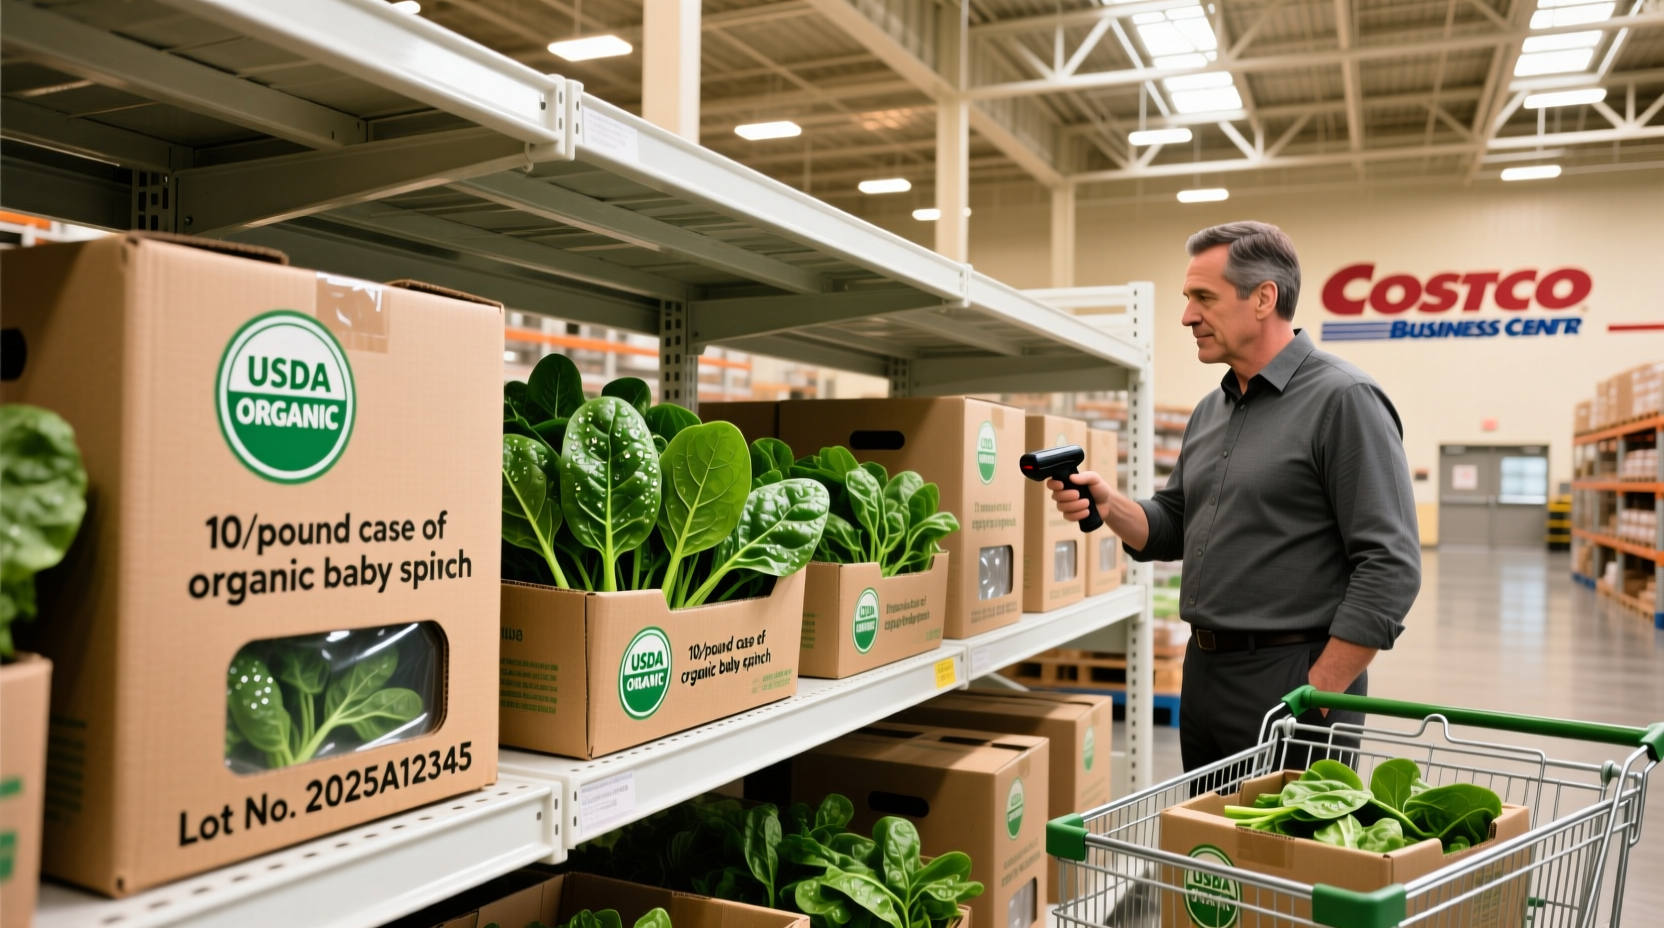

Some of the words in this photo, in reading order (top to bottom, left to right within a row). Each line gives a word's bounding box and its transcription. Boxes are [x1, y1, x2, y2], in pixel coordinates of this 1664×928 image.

[1321, 262, 1593, 316] COSTCO
[1389, 320, 1500, 340] BUSINESS
[247, 355, 332, 393] USDA
[235, 397, 339, 431] ORGANIC
[205, 512, 351, 556] 10/pound
[359, 517, 416, 543] case
[422, 510, 448, 540] of
[188, 558, 315, 605] organic
[324, 555, 393, 593] baby
[631, 650, 664, 672] USDA
[179, 804, 234, 847] Lot
[245, 793, 296, 831] No.
[305, 741, 473, 813] 2025A12345
